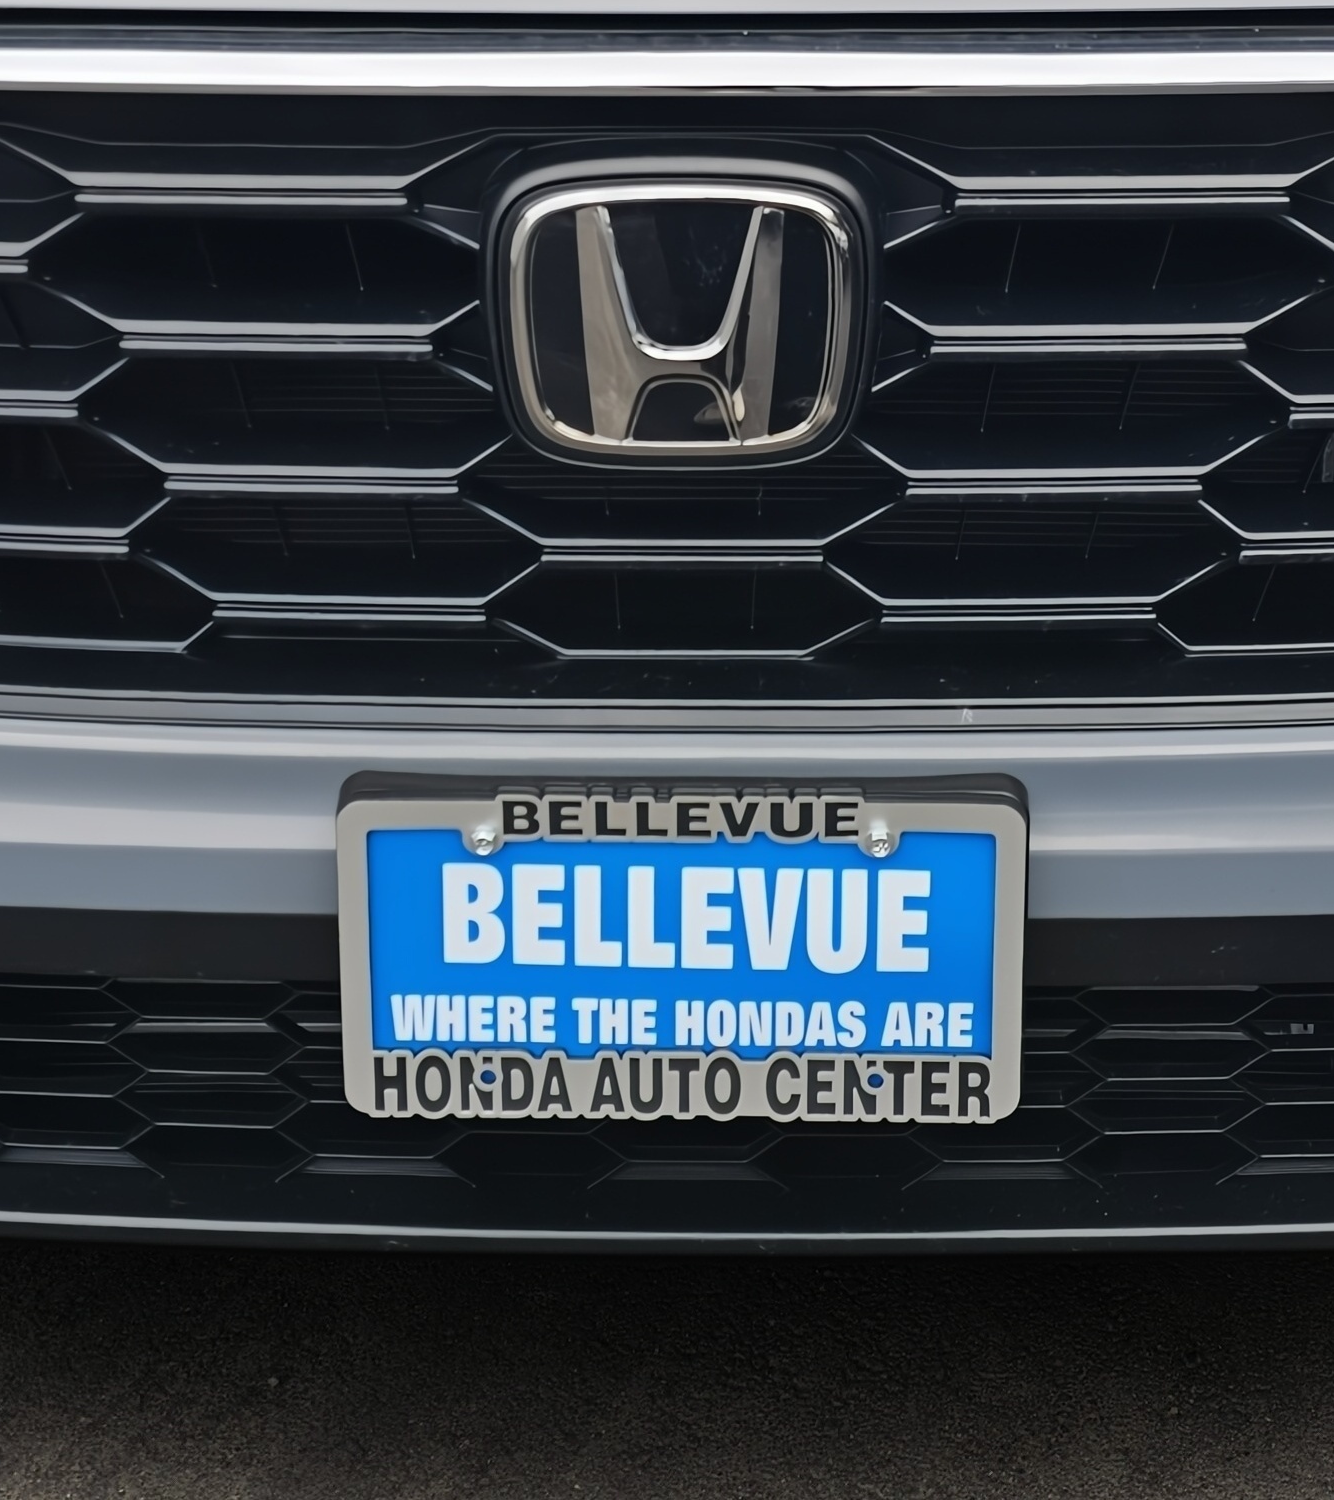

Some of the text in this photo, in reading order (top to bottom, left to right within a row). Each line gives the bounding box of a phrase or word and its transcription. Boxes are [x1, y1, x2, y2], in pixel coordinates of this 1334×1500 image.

[502, 800, 859, 838] BELLEVUE
[441, 862, 932, 975] BELLEVUE
[390, 993, 975, 1049] WHERE THE HONDAS ARE
[373, 1055, 992, 1119] HONDA AUTO CENTER
